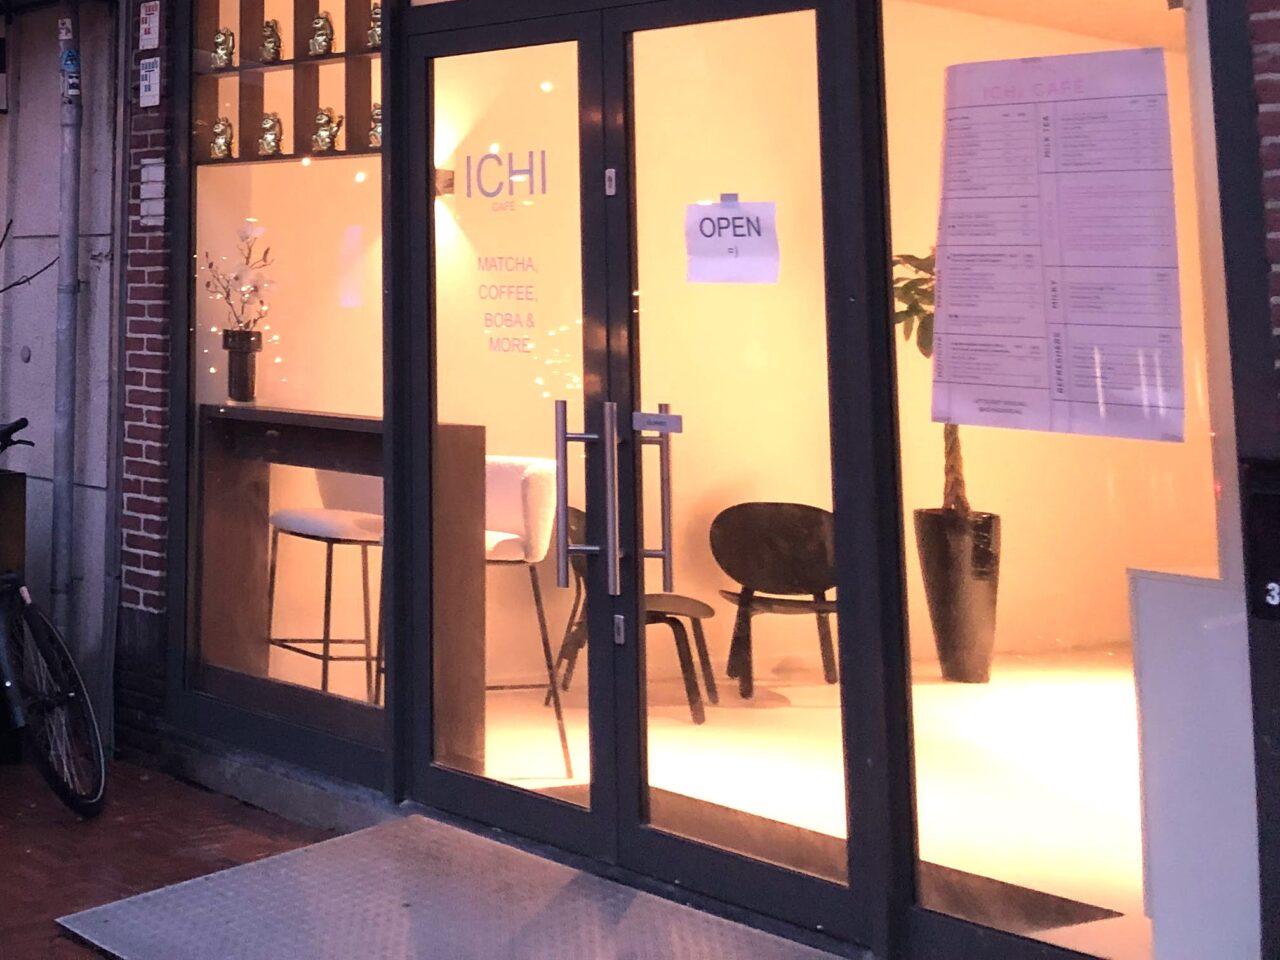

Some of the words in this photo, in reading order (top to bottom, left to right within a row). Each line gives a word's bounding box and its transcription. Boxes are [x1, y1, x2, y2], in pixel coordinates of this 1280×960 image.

[466, 150, 547, 198] ICHI
[699, 216, 762, 239] OPEN
[478, 256, 538, 273] MATCHA,
[479, 284, 538, 302] COFFEE,
[484, 312, 523, 328] BOBA
[526, 312, 535, 328] &
[489, 337, 531, 353] MORE
